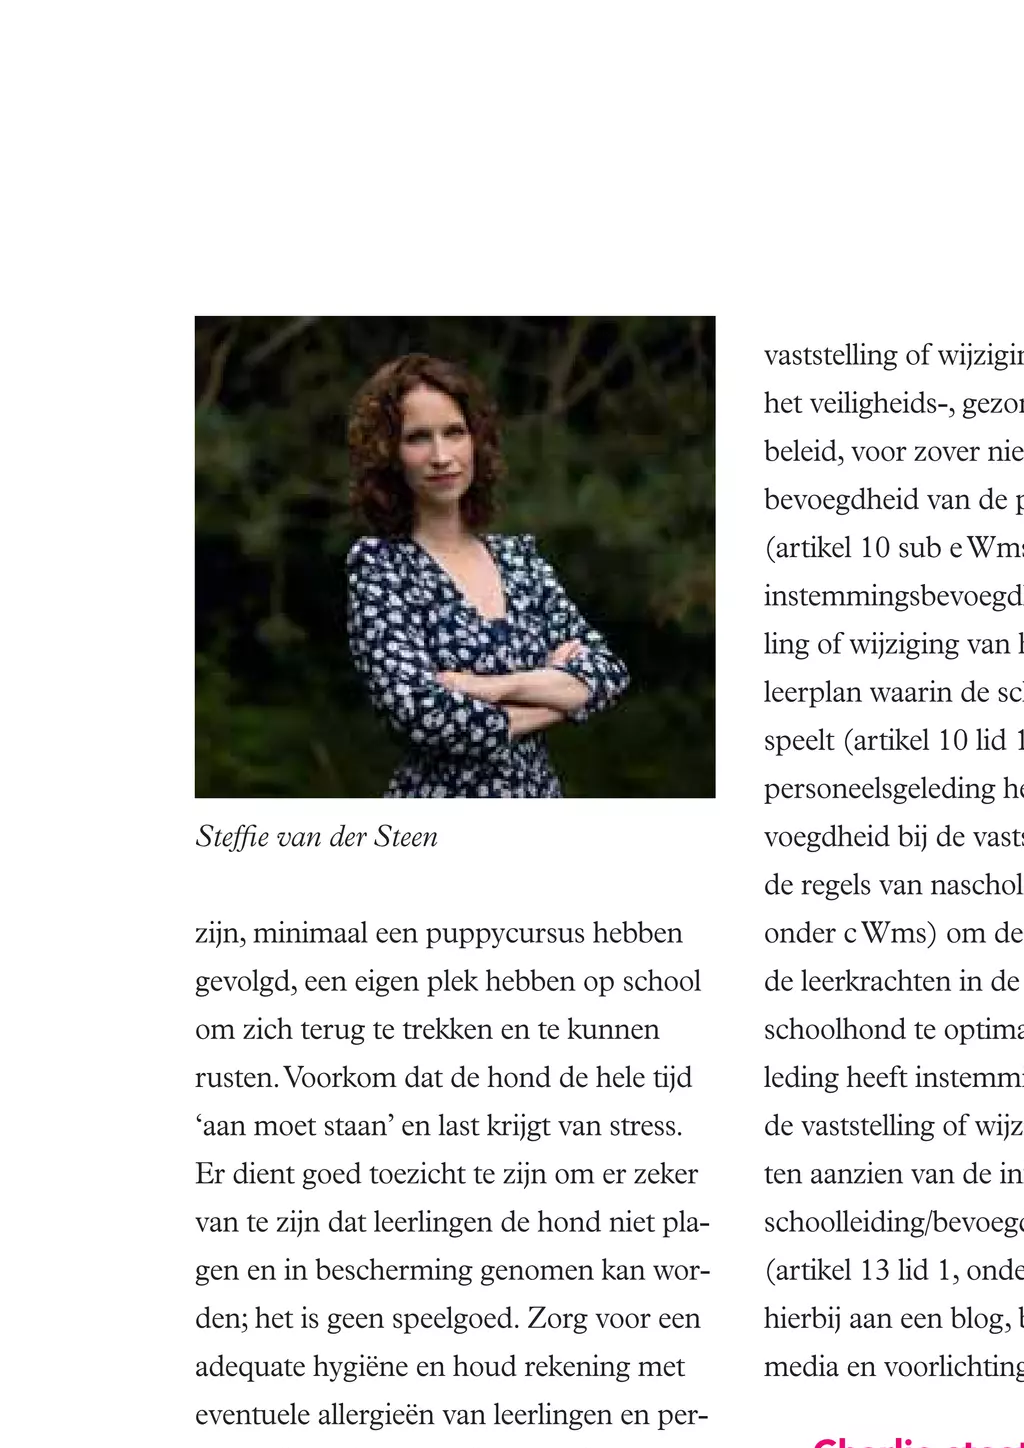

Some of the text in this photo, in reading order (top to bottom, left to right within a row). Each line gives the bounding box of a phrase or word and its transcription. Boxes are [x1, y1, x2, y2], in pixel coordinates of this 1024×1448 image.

[764, 342, 899, 372] vaststelling
[905, 342, 934, 366] of
[195, 823, 438, 853] Steffie van der Steen
[764, 872, 794, 896] de
[801, 872, 871, 901] regels
[878, 879, 923, 896] van
[195, 920, 684, 949] zijn, minimaal een puppycursus hebben
[763, 1064, 840, 1094] leding
[846, 1064, 908, 1088] heeft
[253, 1117, 317, 1137] moet
[401, 1120, 431, 1137] en
[438, 1113, 481, 1137] last
[486, 1113, 552, 1142] krijgt
[557, 1120, 602, 1137] van
[610, 1117, 682, 1137] stress.
[195, 1353, 686, 1383] adequate hygiëne en houd rekening met
[763, 1354, 840, 1378] media
[847, 1361, 877, 1377] en
